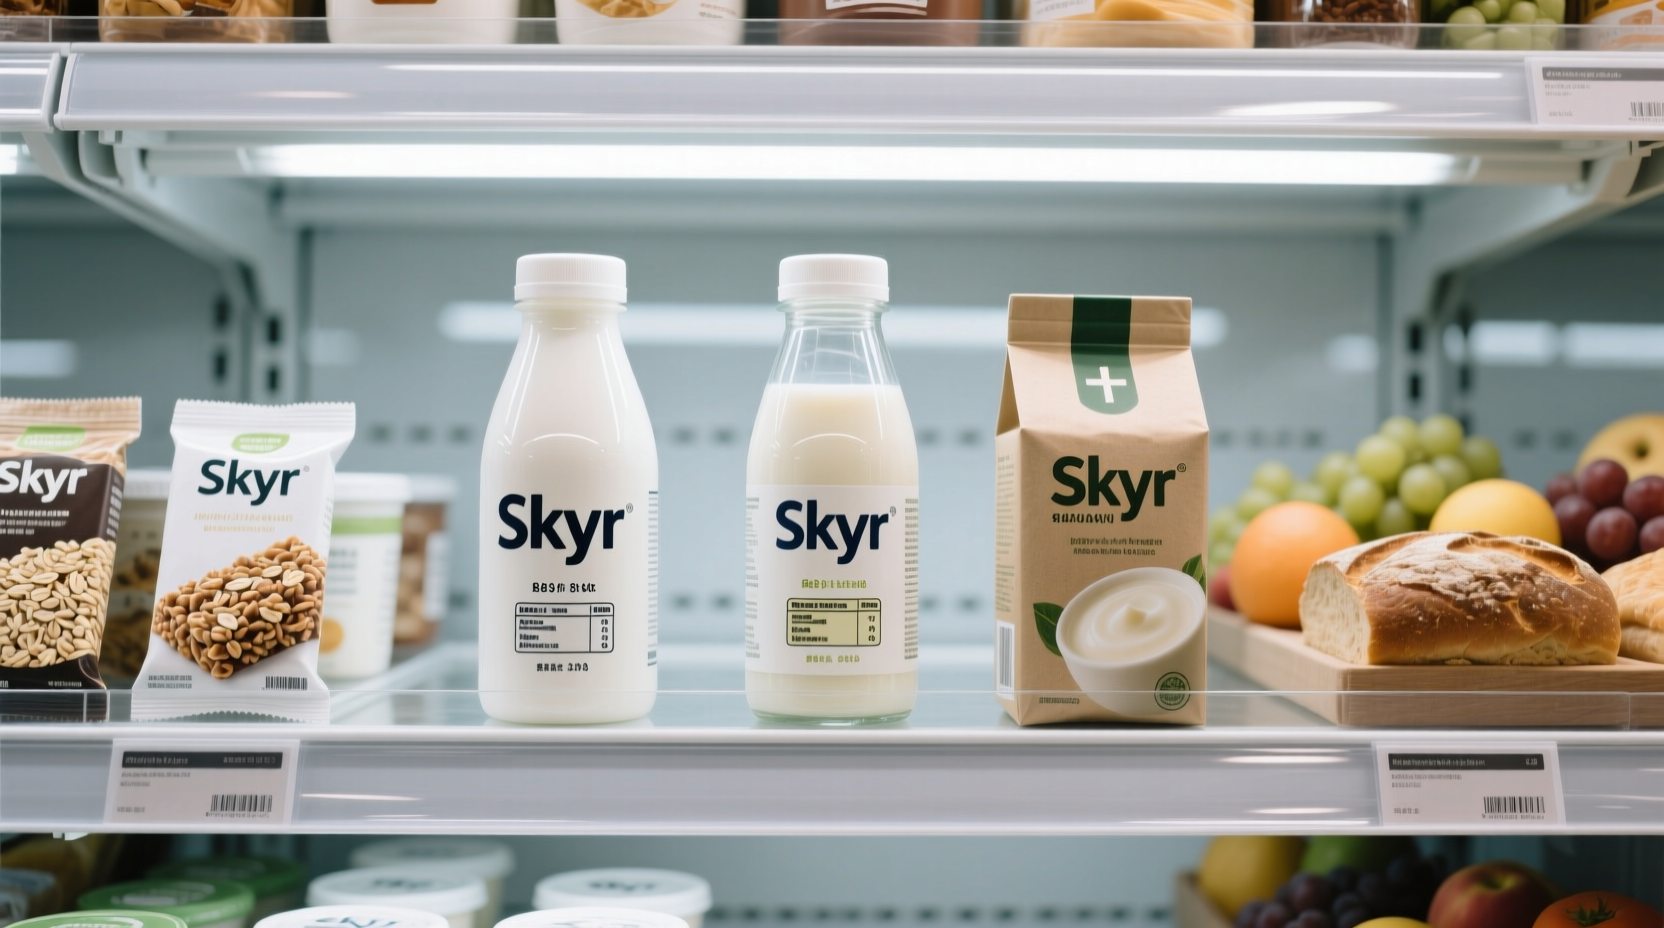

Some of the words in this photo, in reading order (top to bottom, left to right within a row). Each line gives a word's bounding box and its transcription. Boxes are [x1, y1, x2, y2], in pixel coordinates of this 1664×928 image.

[0, 460, 87, 503] Skyr
[198, 459, 300, 506] Skyr
[1051, 455, 1176, 522] Skyr
[498, 494, 625, 565] Skyr
[776, 499, 889, 565] Skyr
